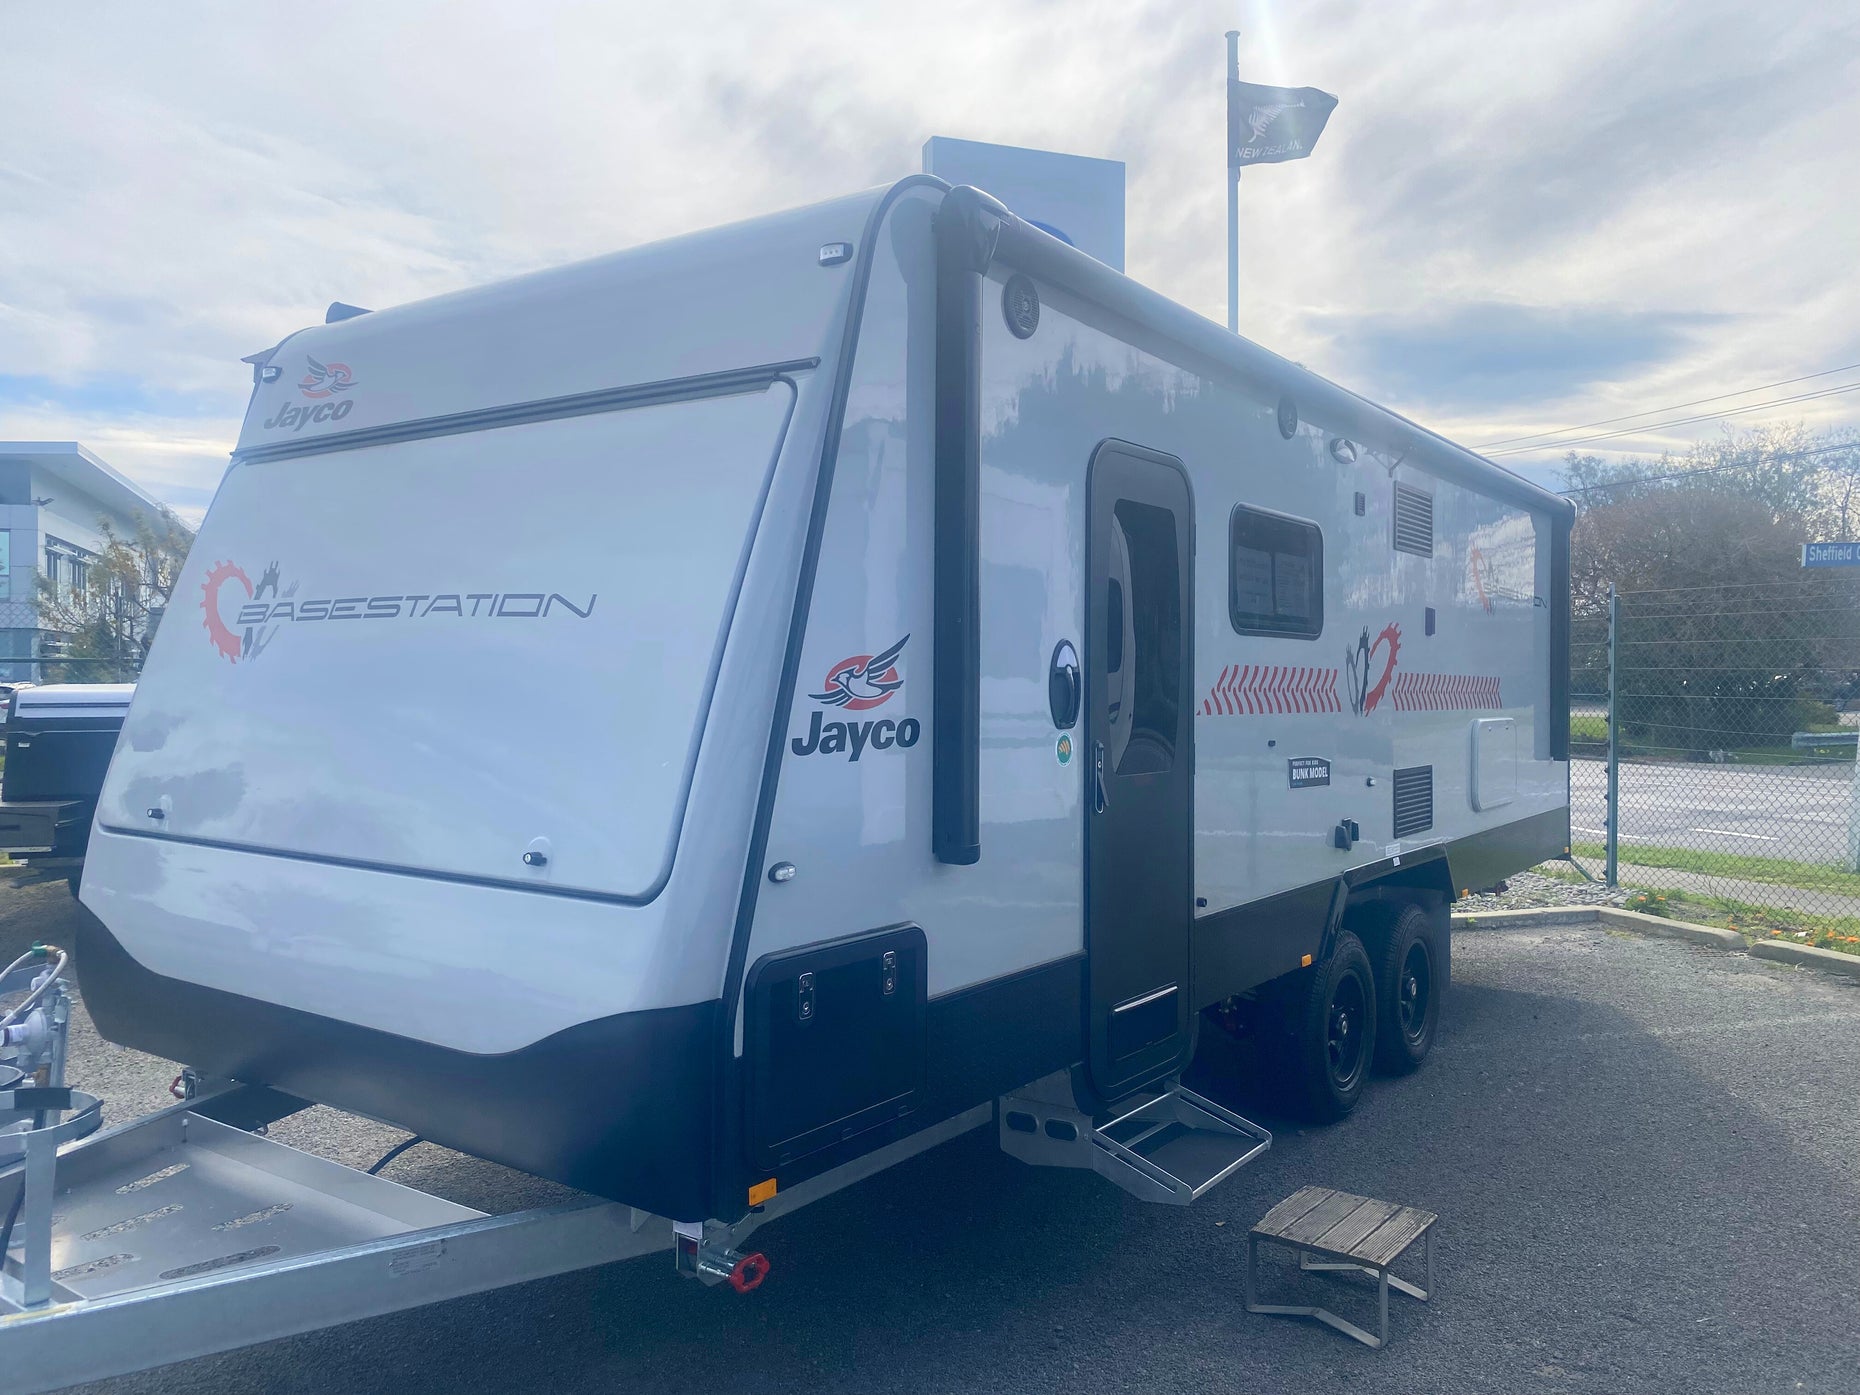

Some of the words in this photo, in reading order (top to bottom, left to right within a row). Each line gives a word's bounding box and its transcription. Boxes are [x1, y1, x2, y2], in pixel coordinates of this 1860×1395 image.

[1236, 147, 1263, 159] NEW
[263, 399, 354, 432] Jayco
[1809, 545, 1853, 561] Sheffield
[236, 593, 597, 625] BASESTATION
[791, 711, 921, 762] Jayco
[1292, 767, 1309, 780] BUNK
[1309, 766, 1328, 779] MODEL
